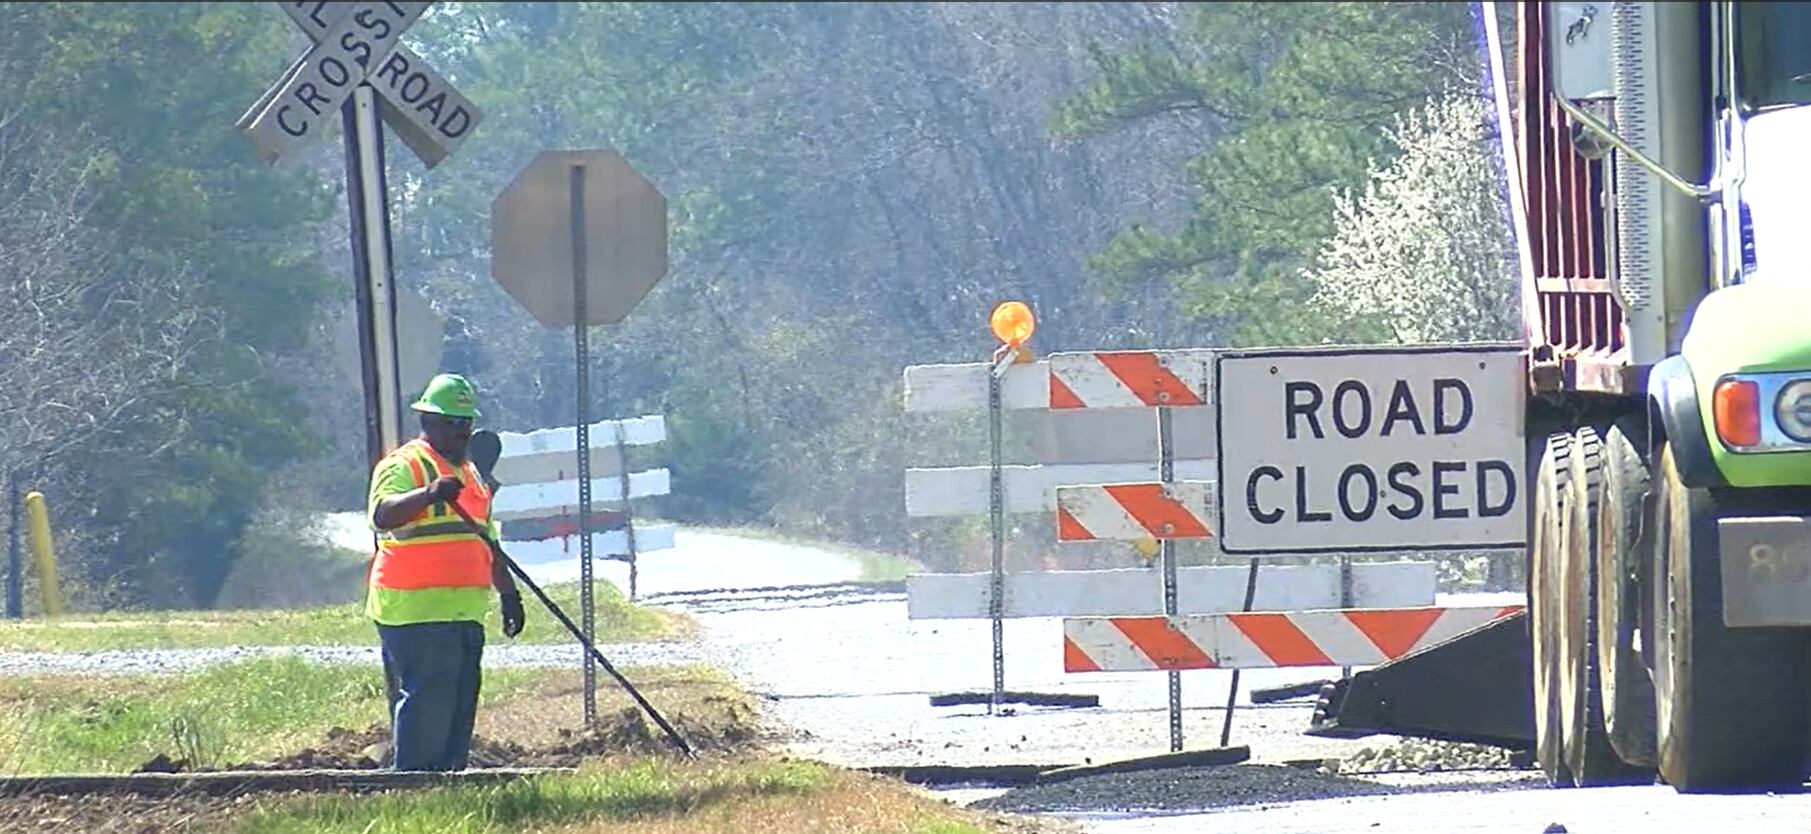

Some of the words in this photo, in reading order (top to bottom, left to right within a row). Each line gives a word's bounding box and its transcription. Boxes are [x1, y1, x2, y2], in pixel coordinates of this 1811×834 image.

[377, 52, 471, 139] ROAD
[1285, 378, 1474, 439] ROAD
[1246, 459, 1517, 524] CLOSED
